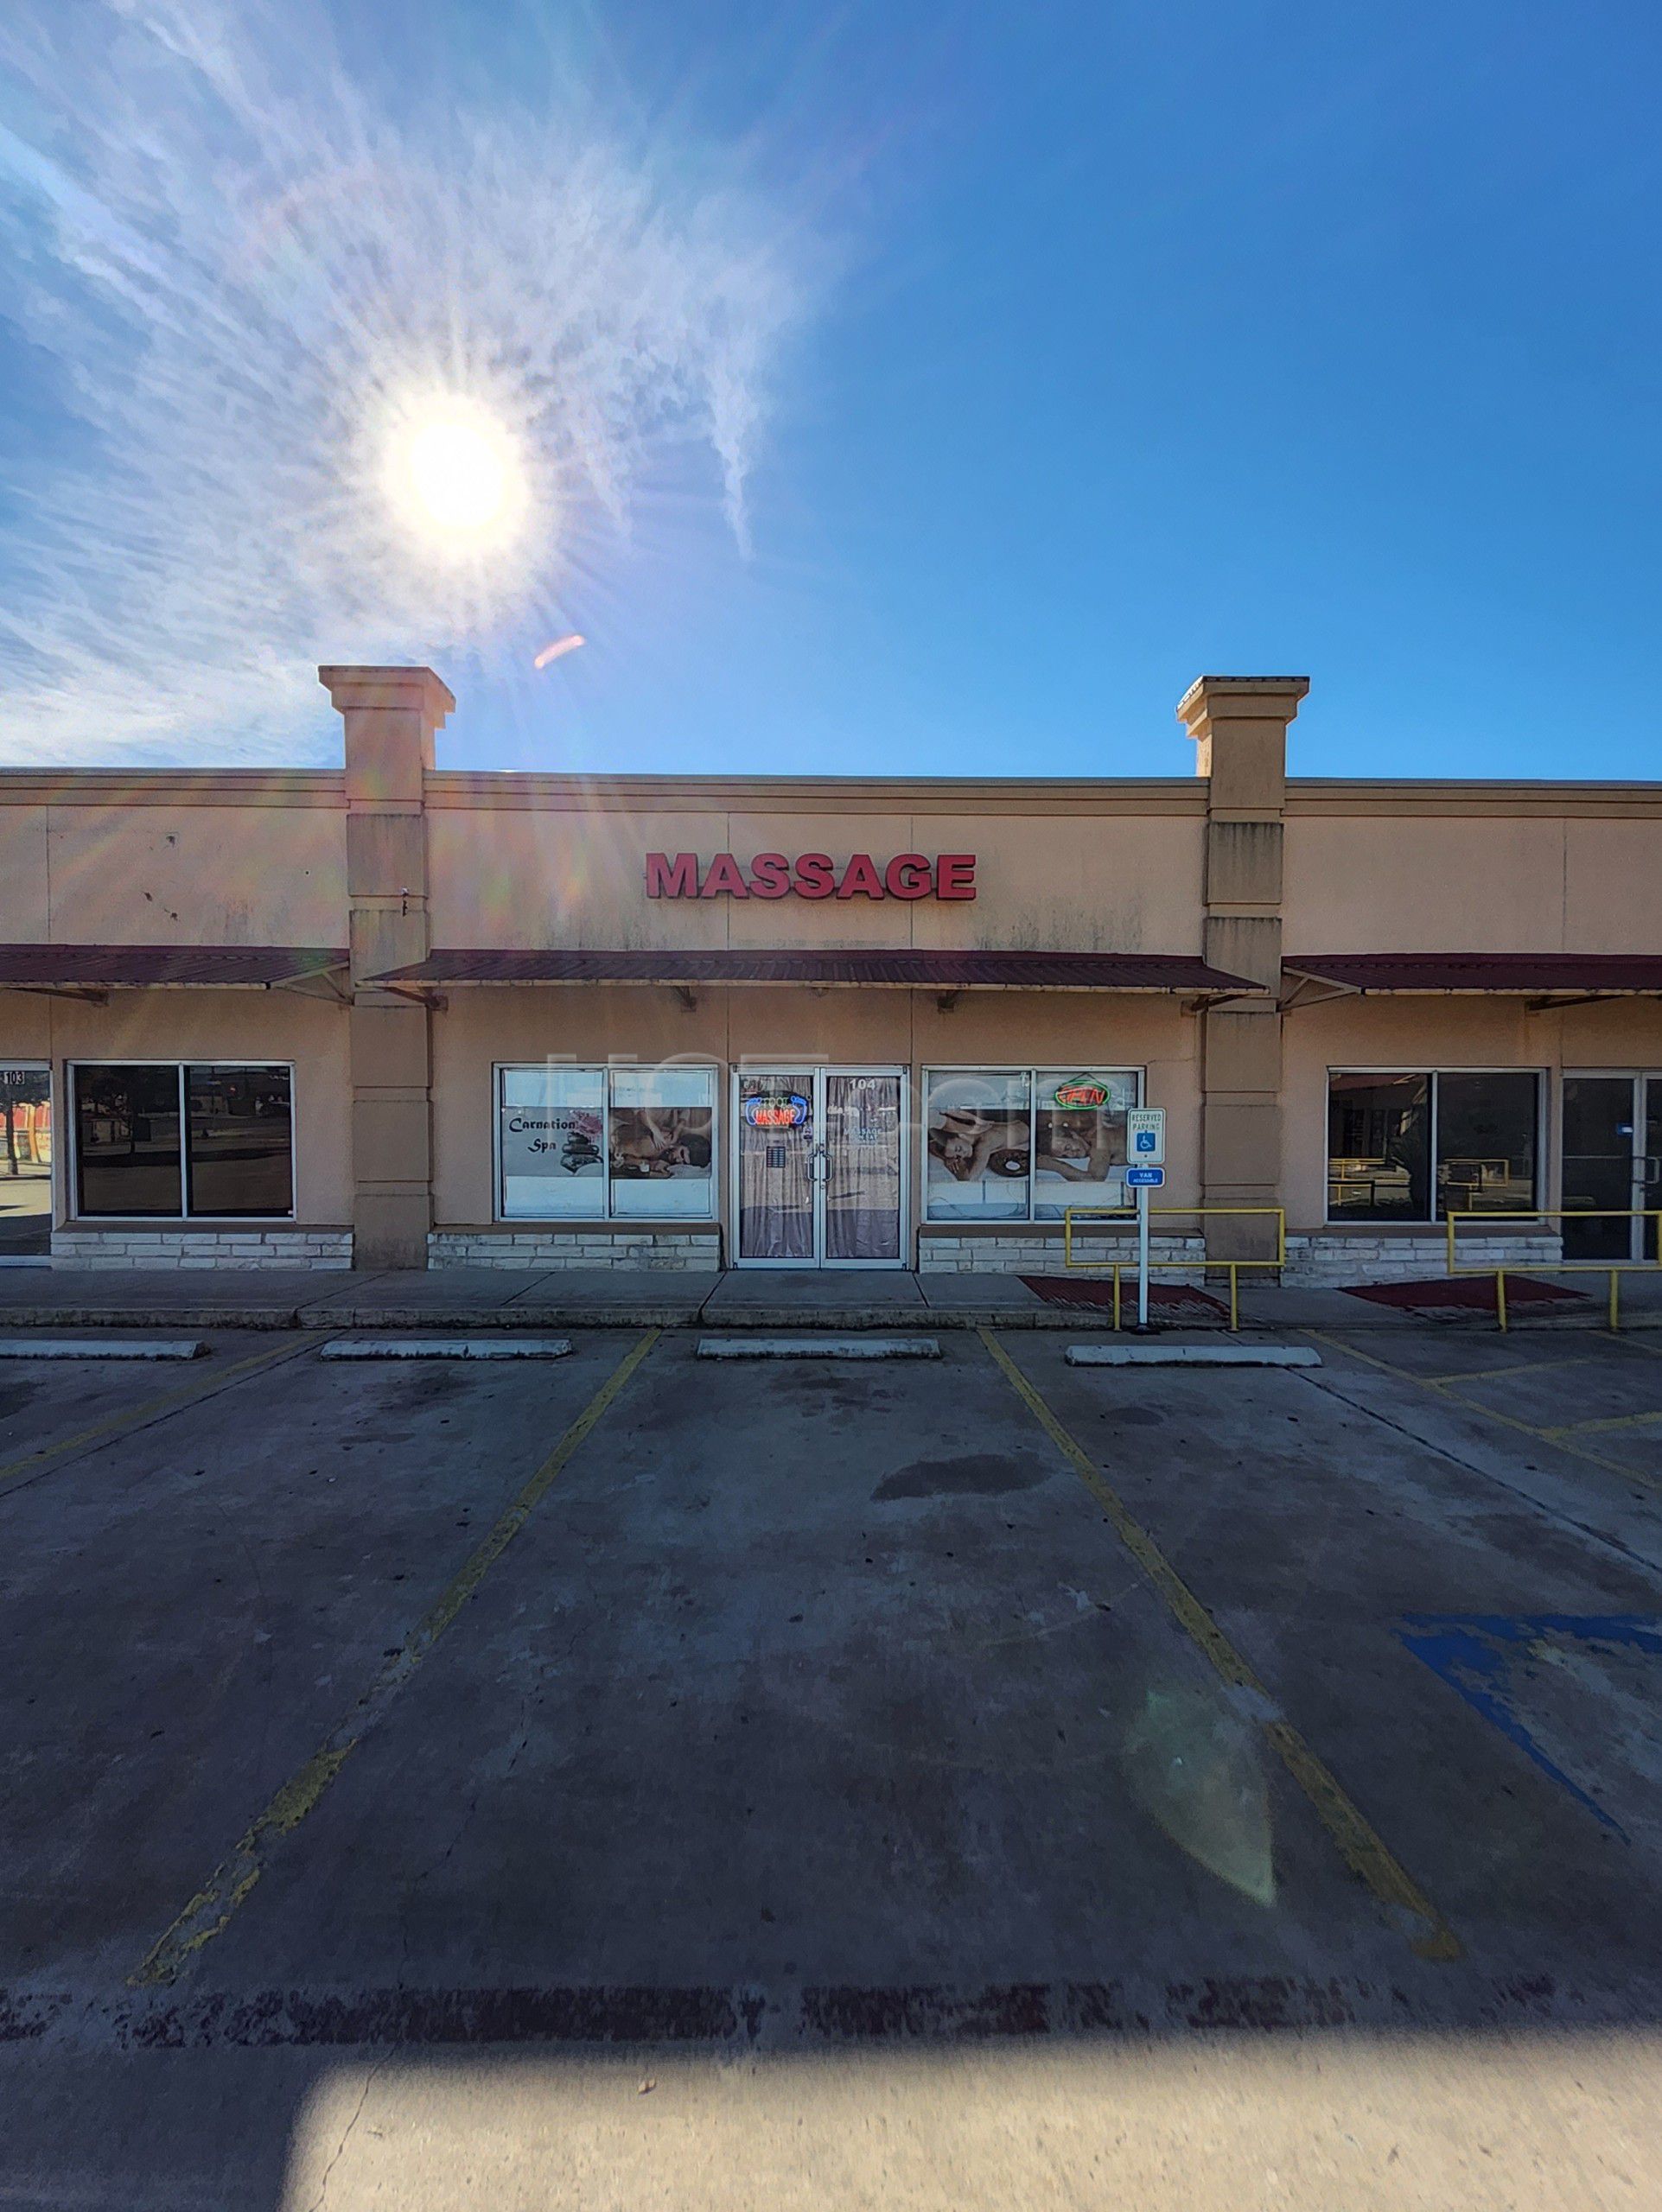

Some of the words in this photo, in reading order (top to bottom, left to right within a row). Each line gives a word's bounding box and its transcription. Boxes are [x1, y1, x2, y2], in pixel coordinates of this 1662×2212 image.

[646, 853, 977, 899] MASSAGE
[6, 1071, 23, 1084] 103
[849, 1078, 876, 1090] 104
[755, 1108, 795, 1125] MASSAGE
[509, 1118, 576, 1132] Carnation
[527, 1138, 557, 1154] Spa
